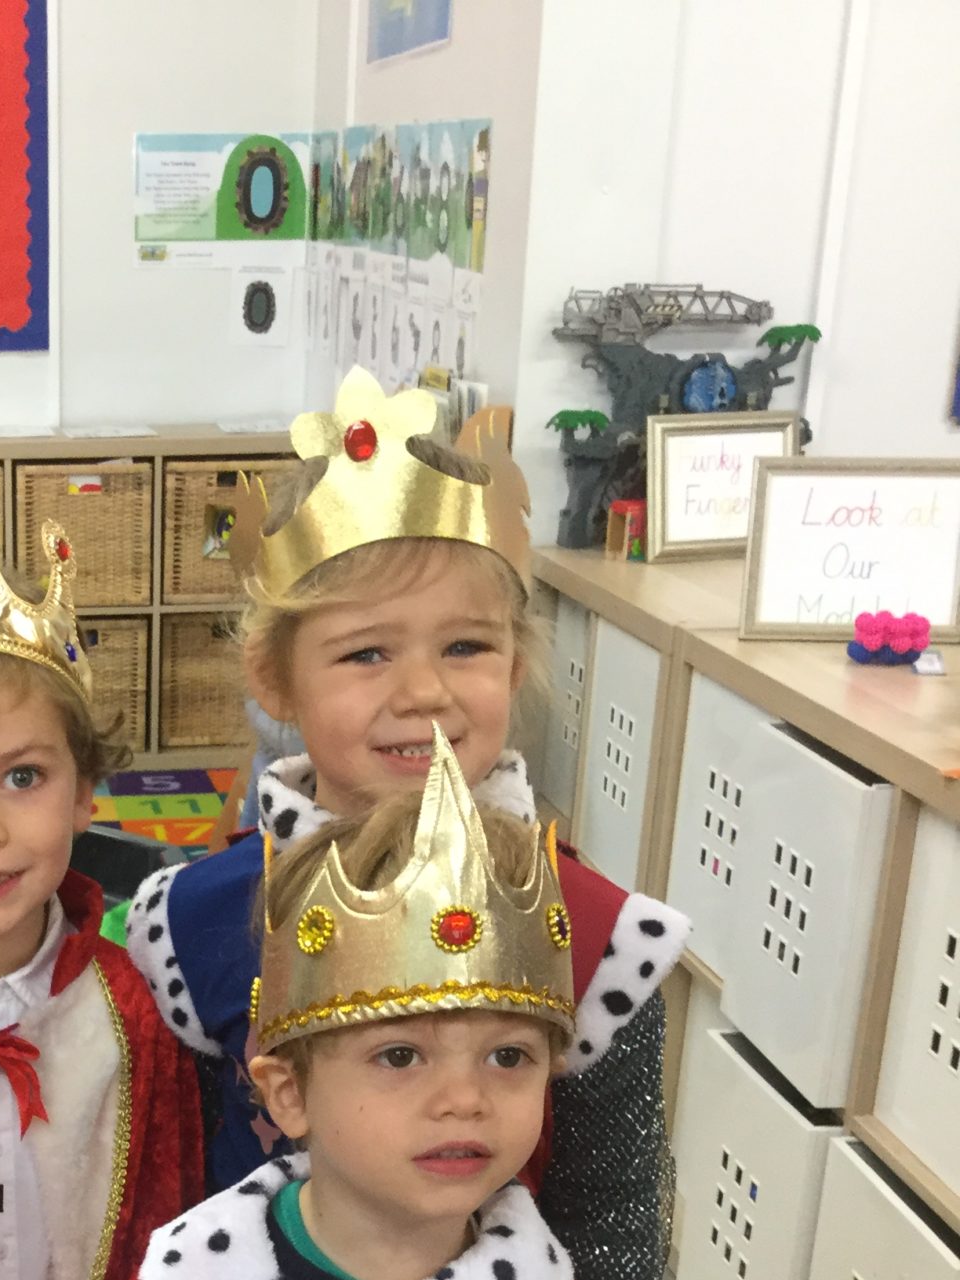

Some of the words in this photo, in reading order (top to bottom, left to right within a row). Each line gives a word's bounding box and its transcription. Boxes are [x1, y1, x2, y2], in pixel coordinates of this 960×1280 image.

[801, 487, 883, 527] Look
[900, 489, 944, 528] at
[823, 542, 880, 579] Our
[141, 775, 182, 791] 5
